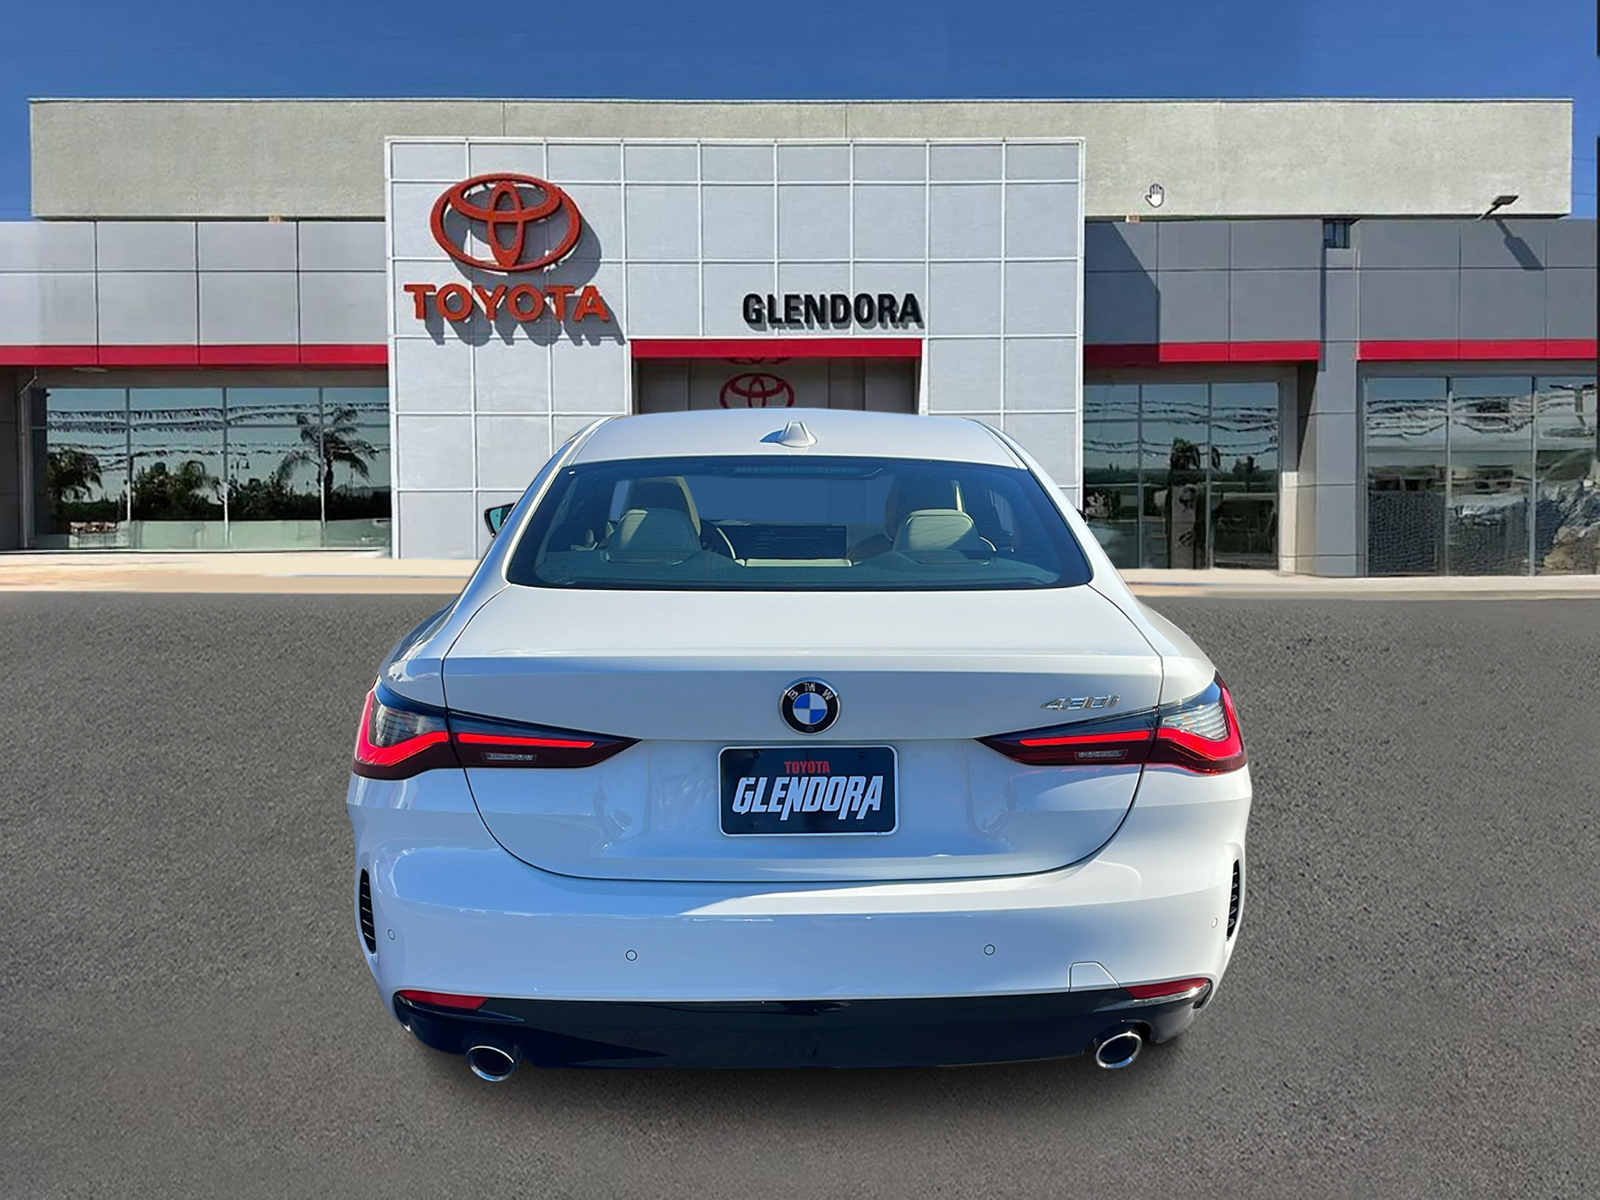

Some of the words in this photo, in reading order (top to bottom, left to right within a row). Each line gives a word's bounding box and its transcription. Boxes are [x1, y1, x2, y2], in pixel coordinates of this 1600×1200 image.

[404, 284, 609, 322] TOYOTA
[743, 293, 922, 326] GLENDORA
[787, 682, 834, 701] BMW
[1040, 695, 1120, 711] 430i
[784, 760, 830, 774] TOYOTA
[732, 775, 884, 821] GLENDORA
